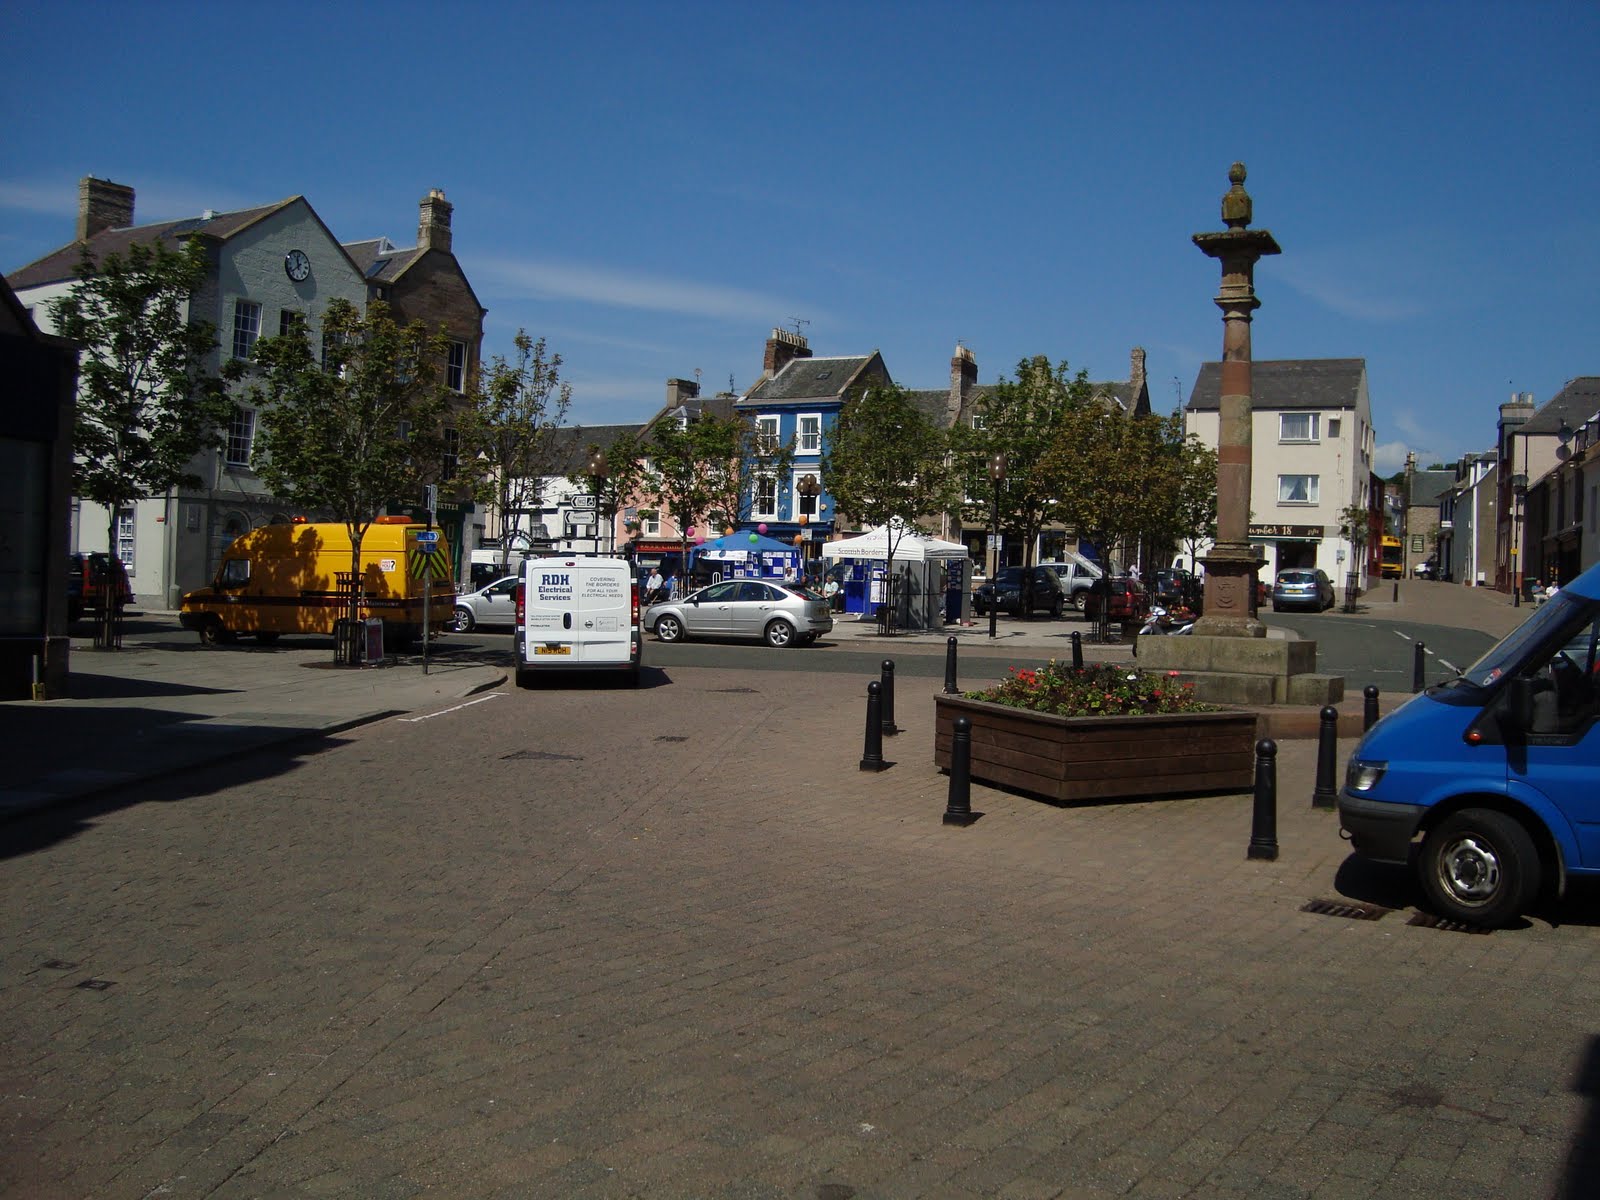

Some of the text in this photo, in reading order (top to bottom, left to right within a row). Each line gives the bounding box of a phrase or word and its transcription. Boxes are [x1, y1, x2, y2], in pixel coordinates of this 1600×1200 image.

[1248, 525, 1278, 535] umber
[1281, 525, 1293, 536] 18
[861, 548, 884, 556] Borders
[541, 574, 570, 586] RDH
